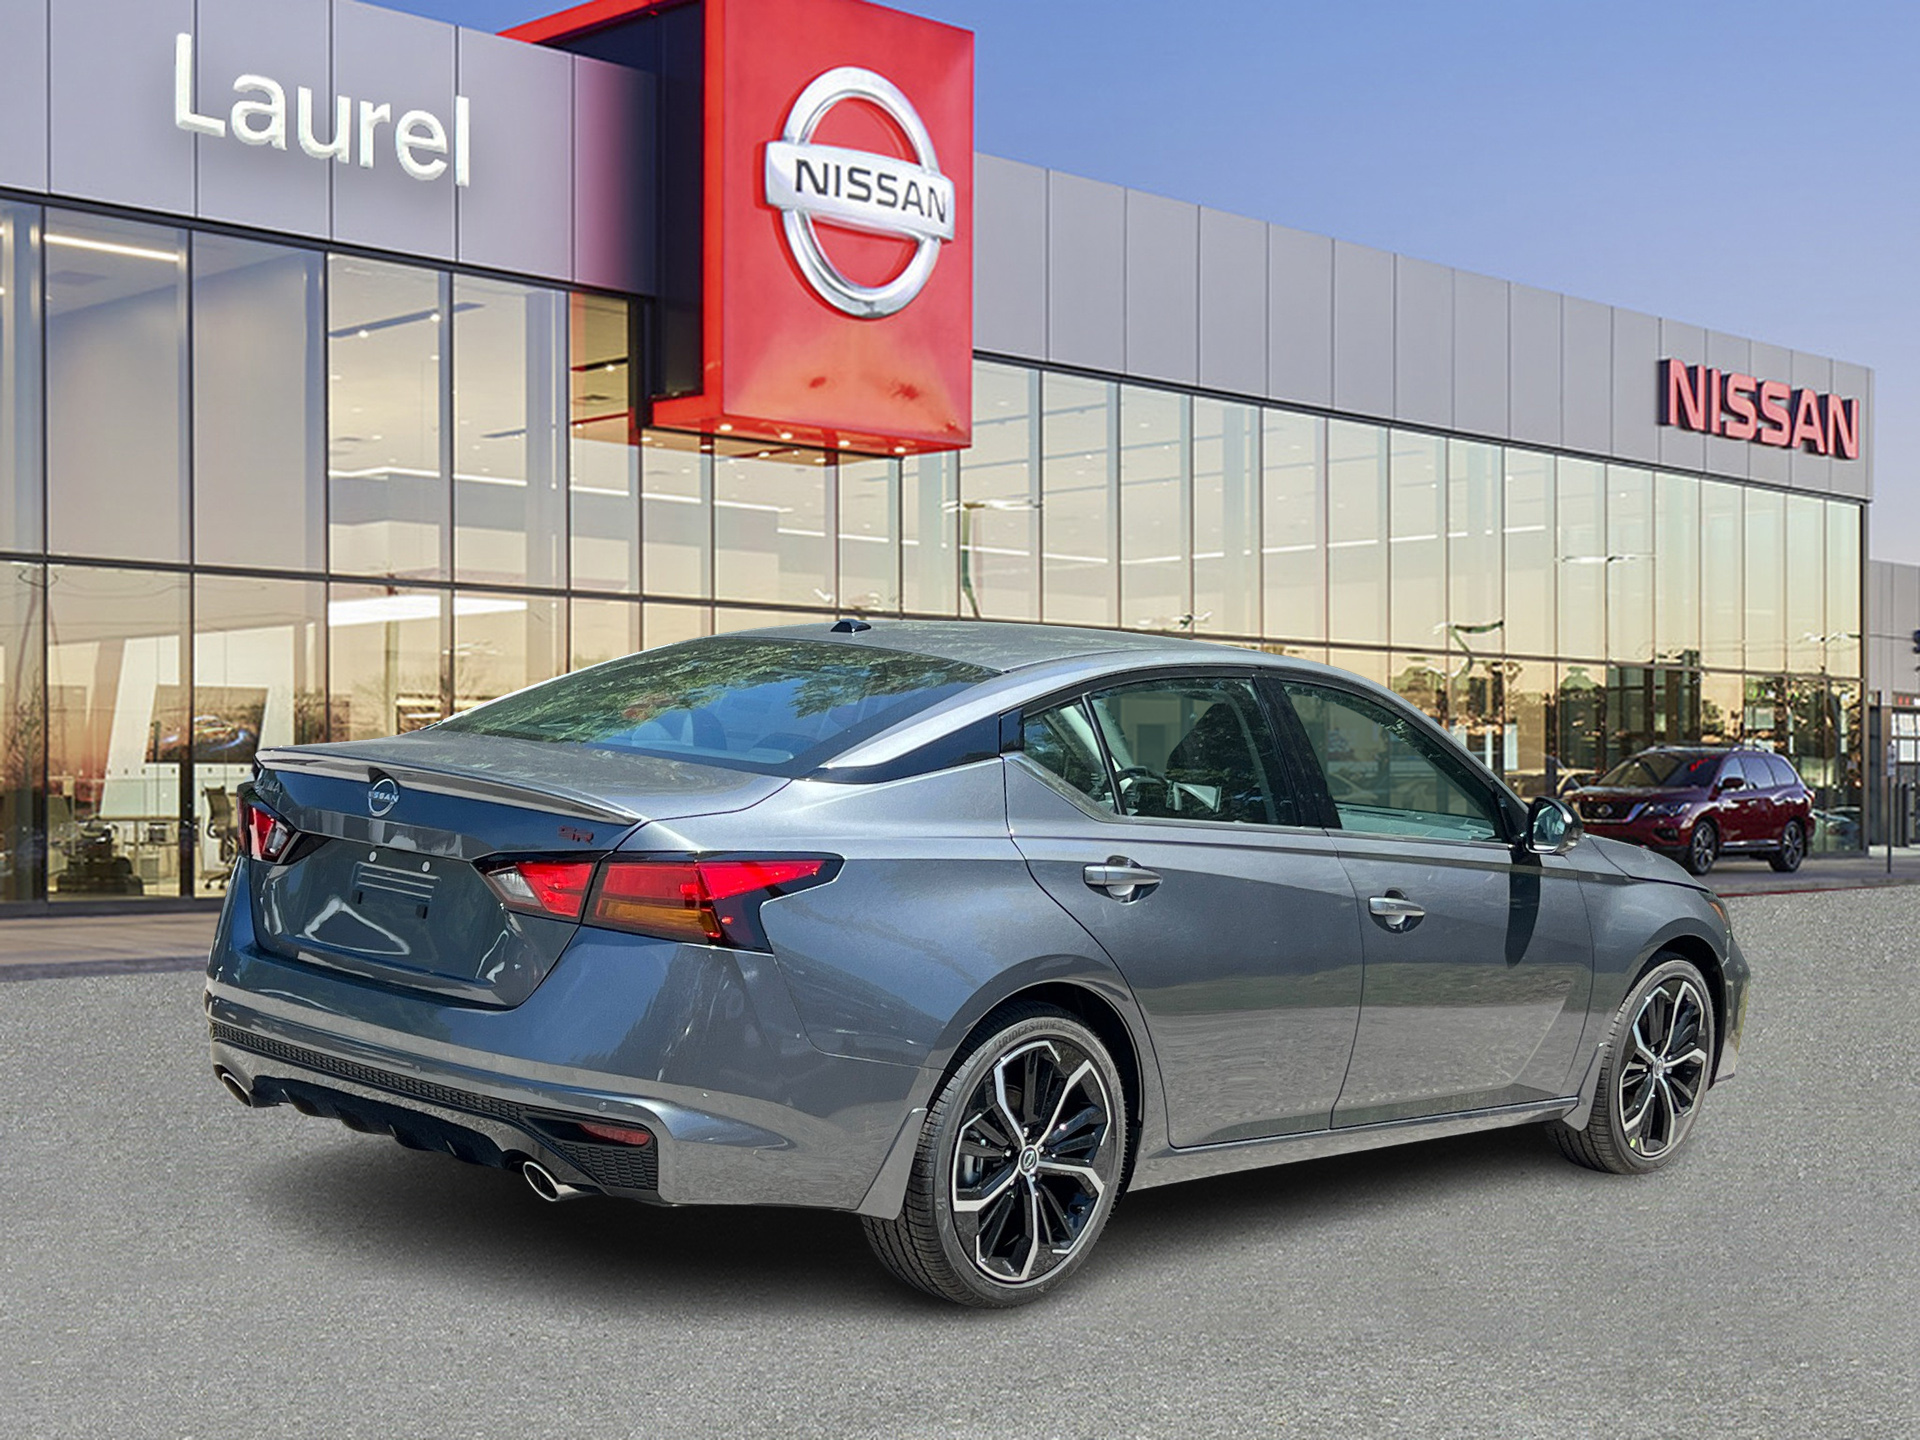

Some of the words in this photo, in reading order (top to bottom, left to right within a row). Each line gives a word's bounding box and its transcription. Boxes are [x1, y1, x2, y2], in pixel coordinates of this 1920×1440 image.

[175, 33, 469, 187] Laurel
[795, 158, 946, 223] NISSAN
[1658, 358, 1859, 459] NISSAN
